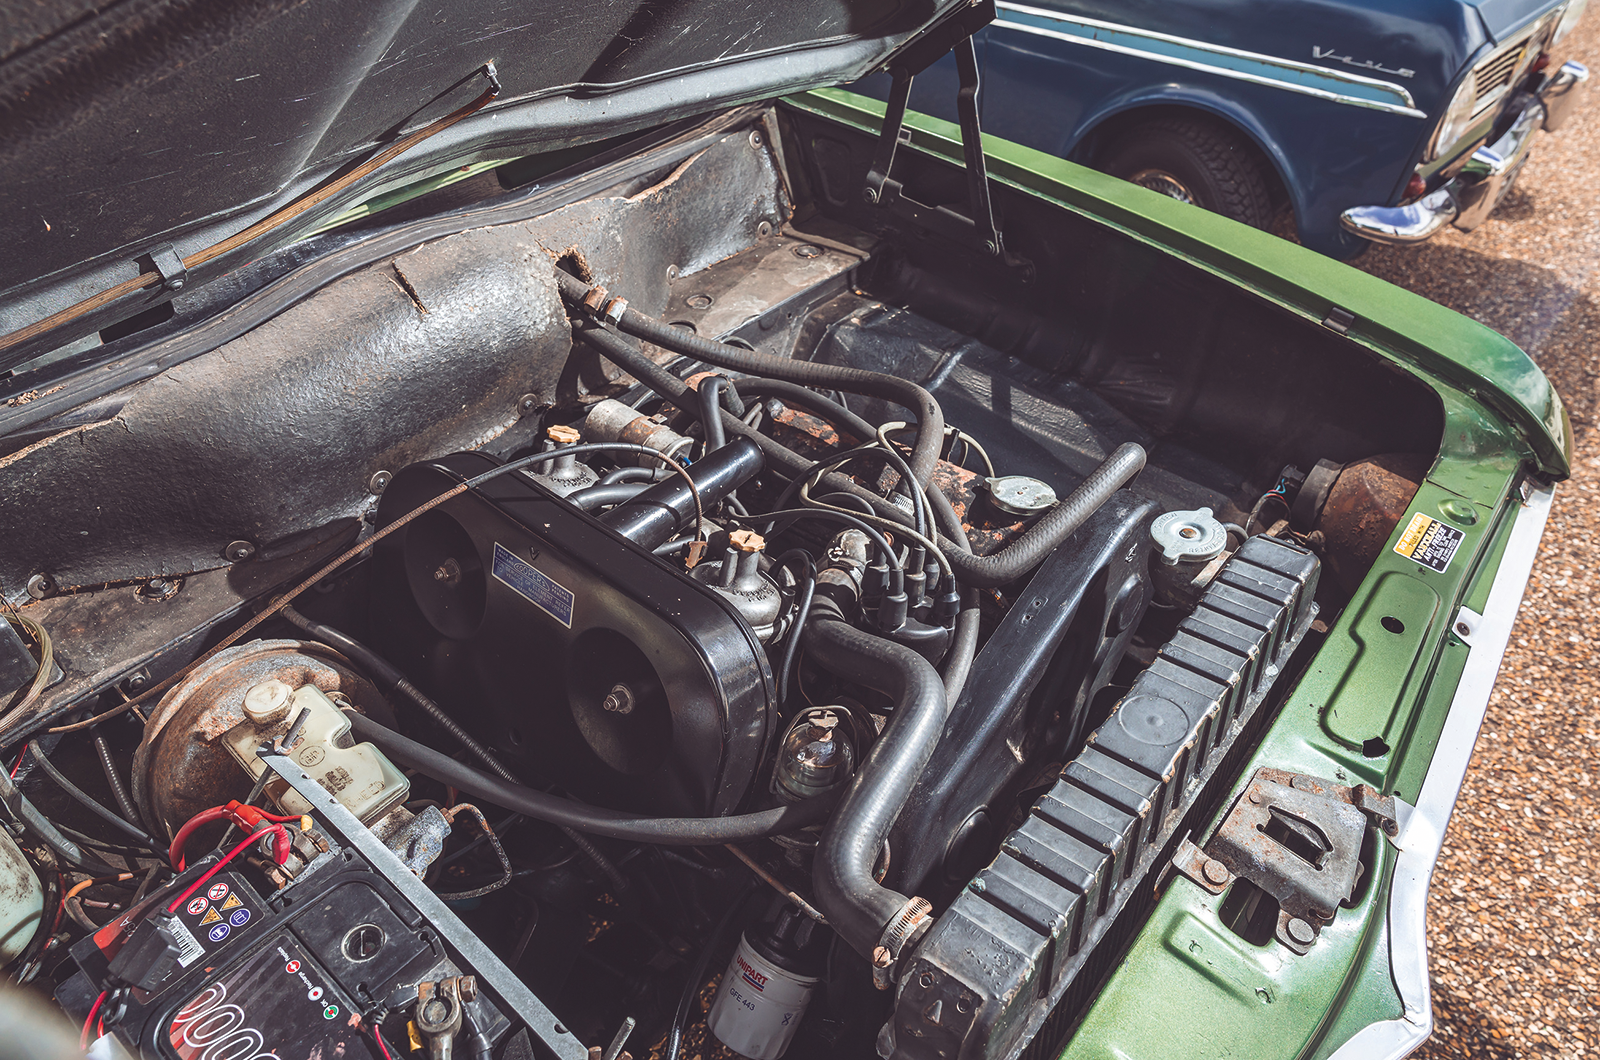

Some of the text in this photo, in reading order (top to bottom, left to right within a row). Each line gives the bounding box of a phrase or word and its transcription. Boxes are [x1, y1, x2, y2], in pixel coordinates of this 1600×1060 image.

[1398, 540, 1408, 551] DO
[1412, 522, 1441, 560] VAUXHALL
[737, 954, 768, 985] UNIPART
[320, 998, 329, 1007] OK
[730, 987, 755, 1011] GFE 443
